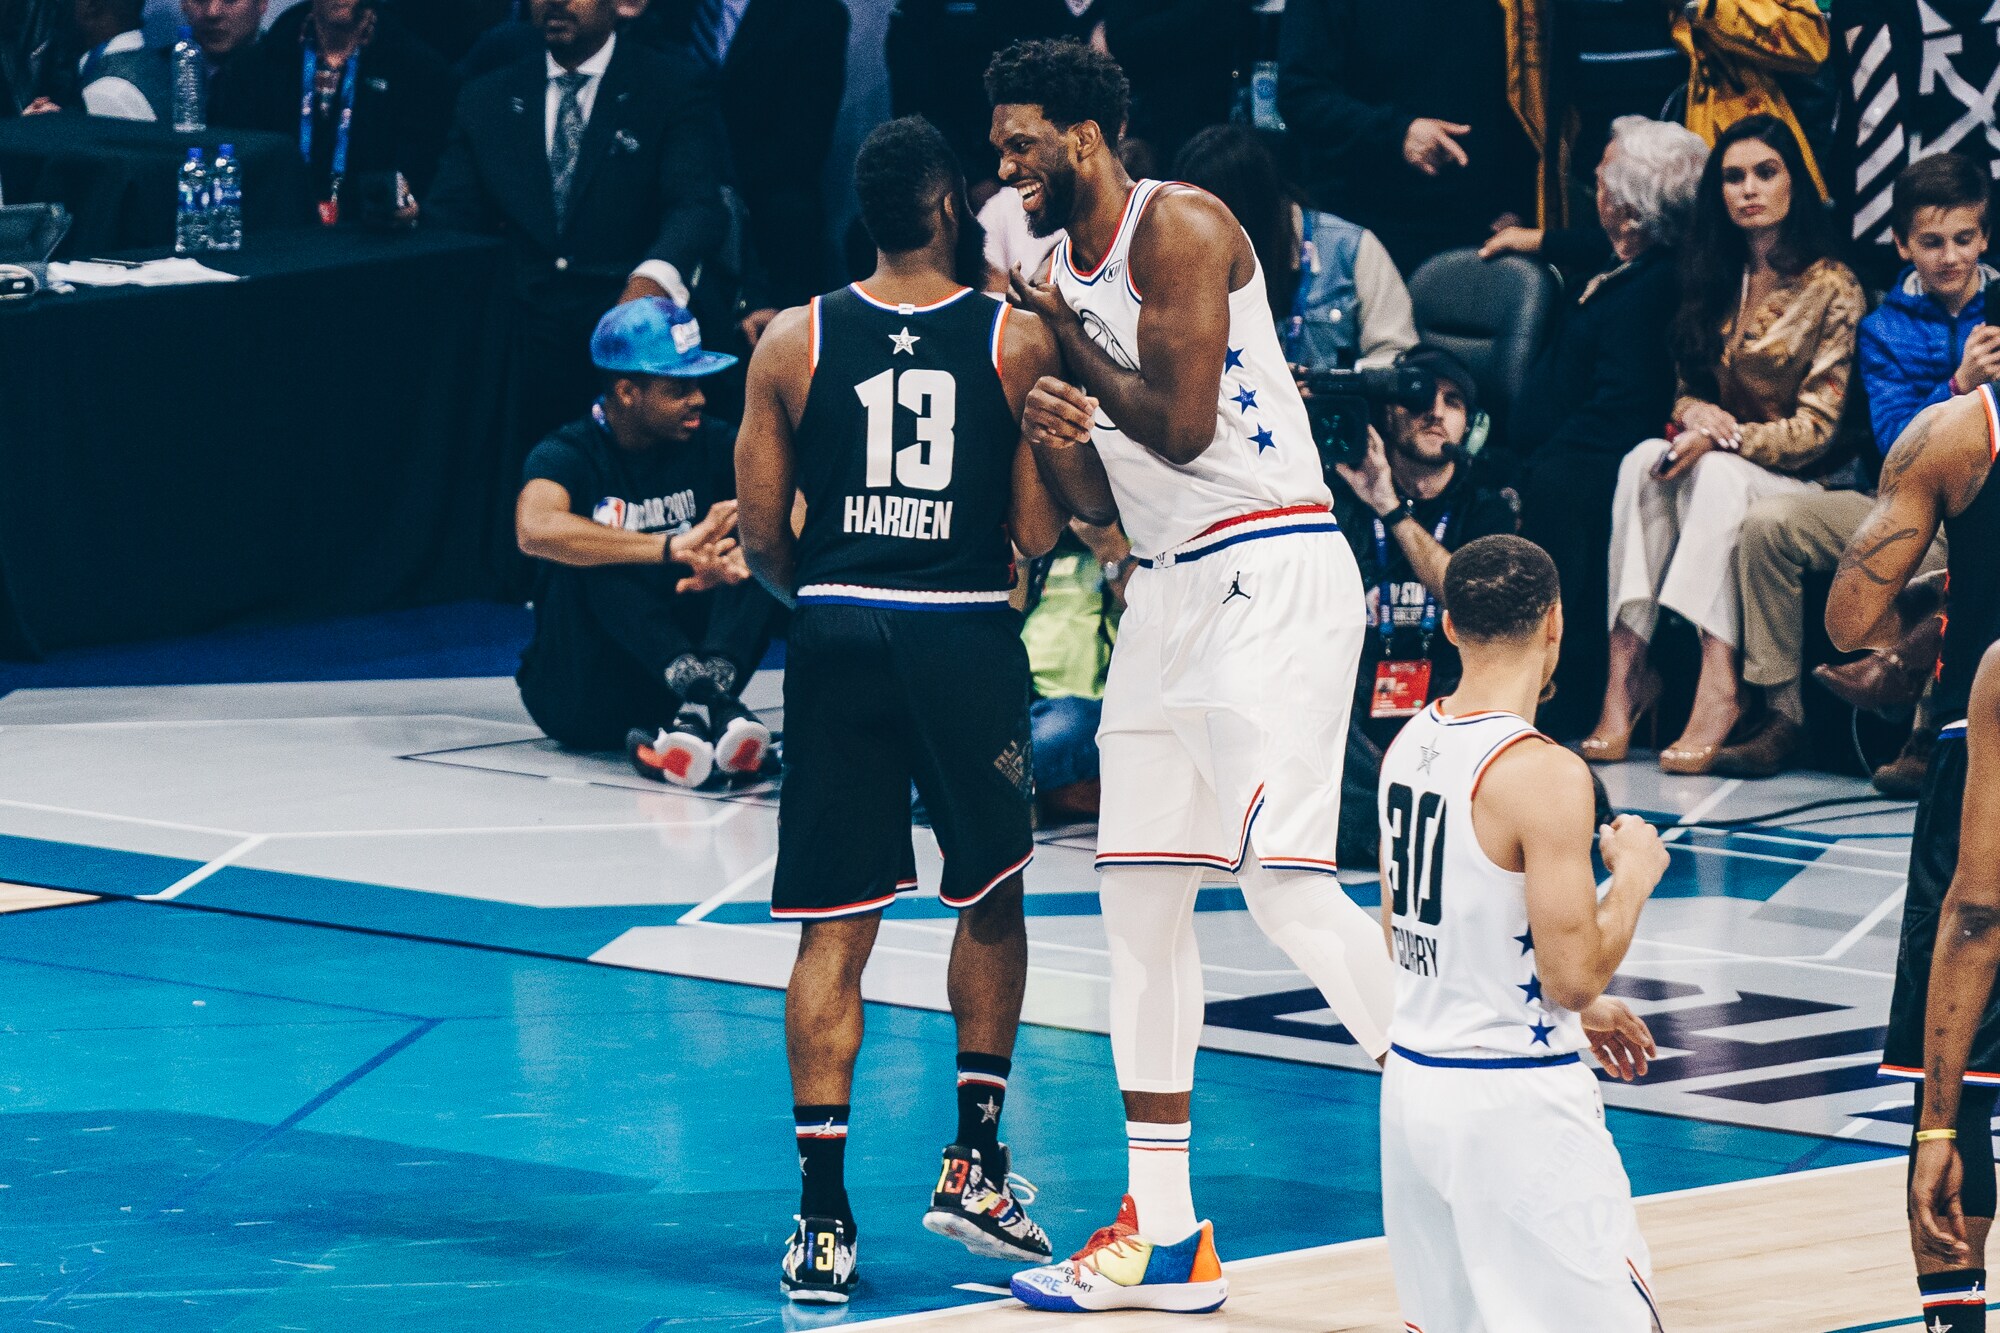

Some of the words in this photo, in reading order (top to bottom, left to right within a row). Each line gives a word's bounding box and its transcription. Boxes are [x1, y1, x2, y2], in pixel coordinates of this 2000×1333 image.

[853, 367, 957, 491] 13
[843, 494, 953, 540] HARDEN
[1387, 781, 1447, 926] 30
[936, 1158, 970, 1194] 13
[1064, 1275, 1094, 1293] START
